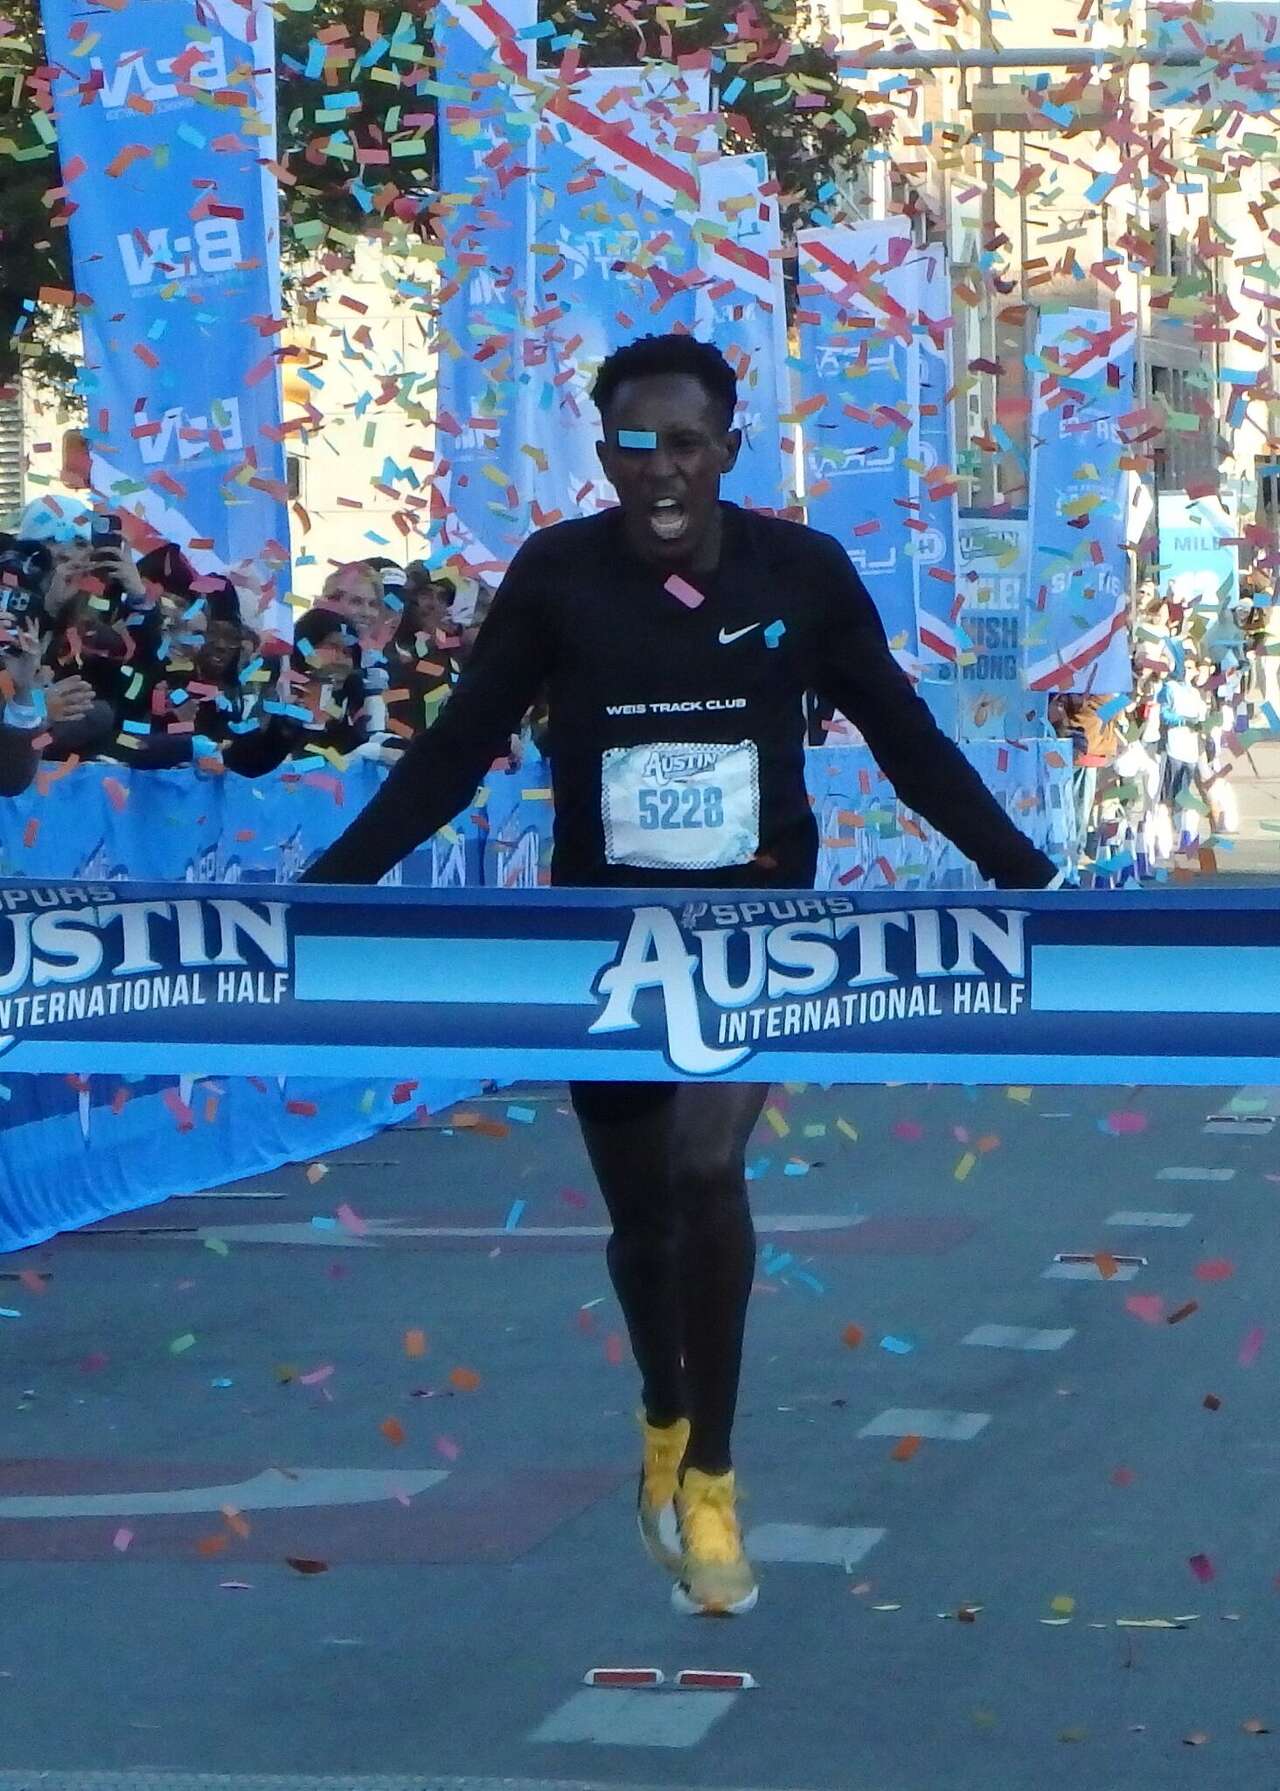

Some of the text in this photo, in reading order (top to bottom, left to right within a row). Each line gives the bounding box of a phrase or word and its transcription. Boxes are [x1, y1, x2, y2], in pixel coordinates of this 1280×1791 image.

[606, 698, 747, 715] WEIS TRACK CLUB
[641, 751, 718, 786] AUSTIN
[639, 787, 724, 829] 5228
[0, 886, 115, 911] PURS
[711, 897, 854, 925] SPURS
[0, 900, 291, 995] USTIN
[218, 972, 289, 1004] HALF
[588, 905, 1030, 1073] AUSTIN
[718, 982, 1025, 1043] INTERNATIONAL HALF
